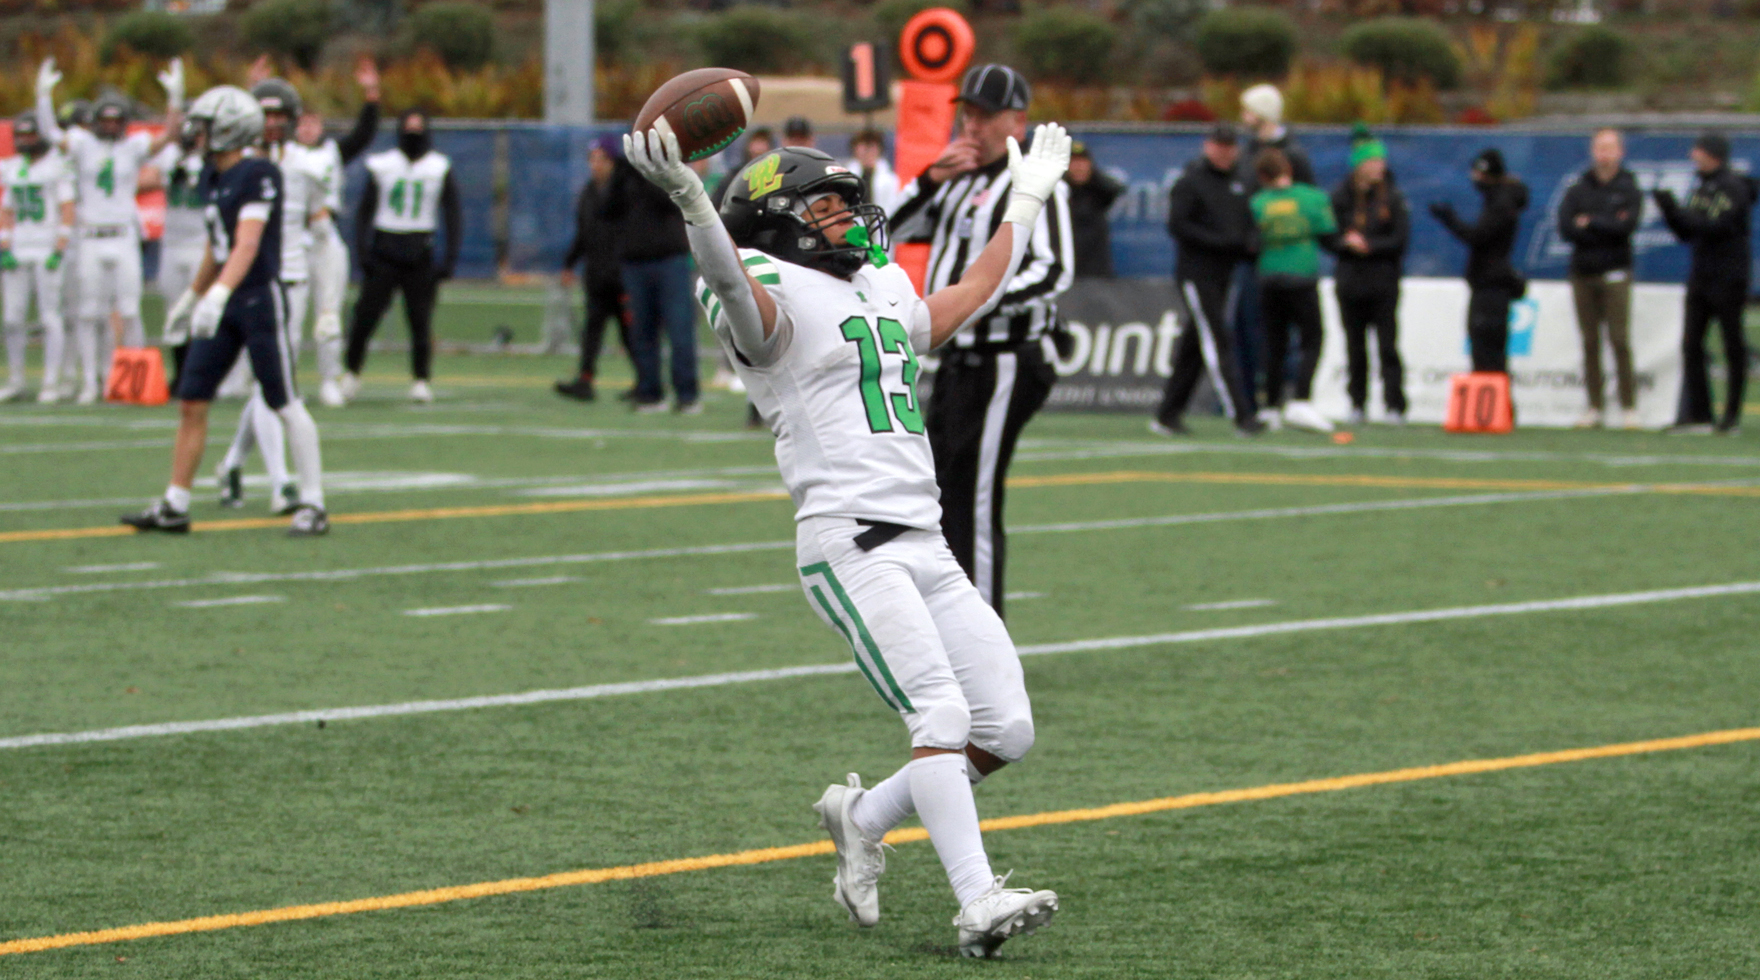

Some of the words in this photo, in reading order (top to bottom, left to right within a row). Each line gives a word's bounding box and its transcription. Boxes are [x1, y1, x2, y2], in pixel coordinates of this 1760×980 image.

[849, 42, 875, 99] 1
[97, 158, 114, 198] 4
[388, 178, 424, 218] 41
[110, 357, 148, 401] 20
[839, 315, 926, 435] 13
[1455, 383, 1497, 428] 10
